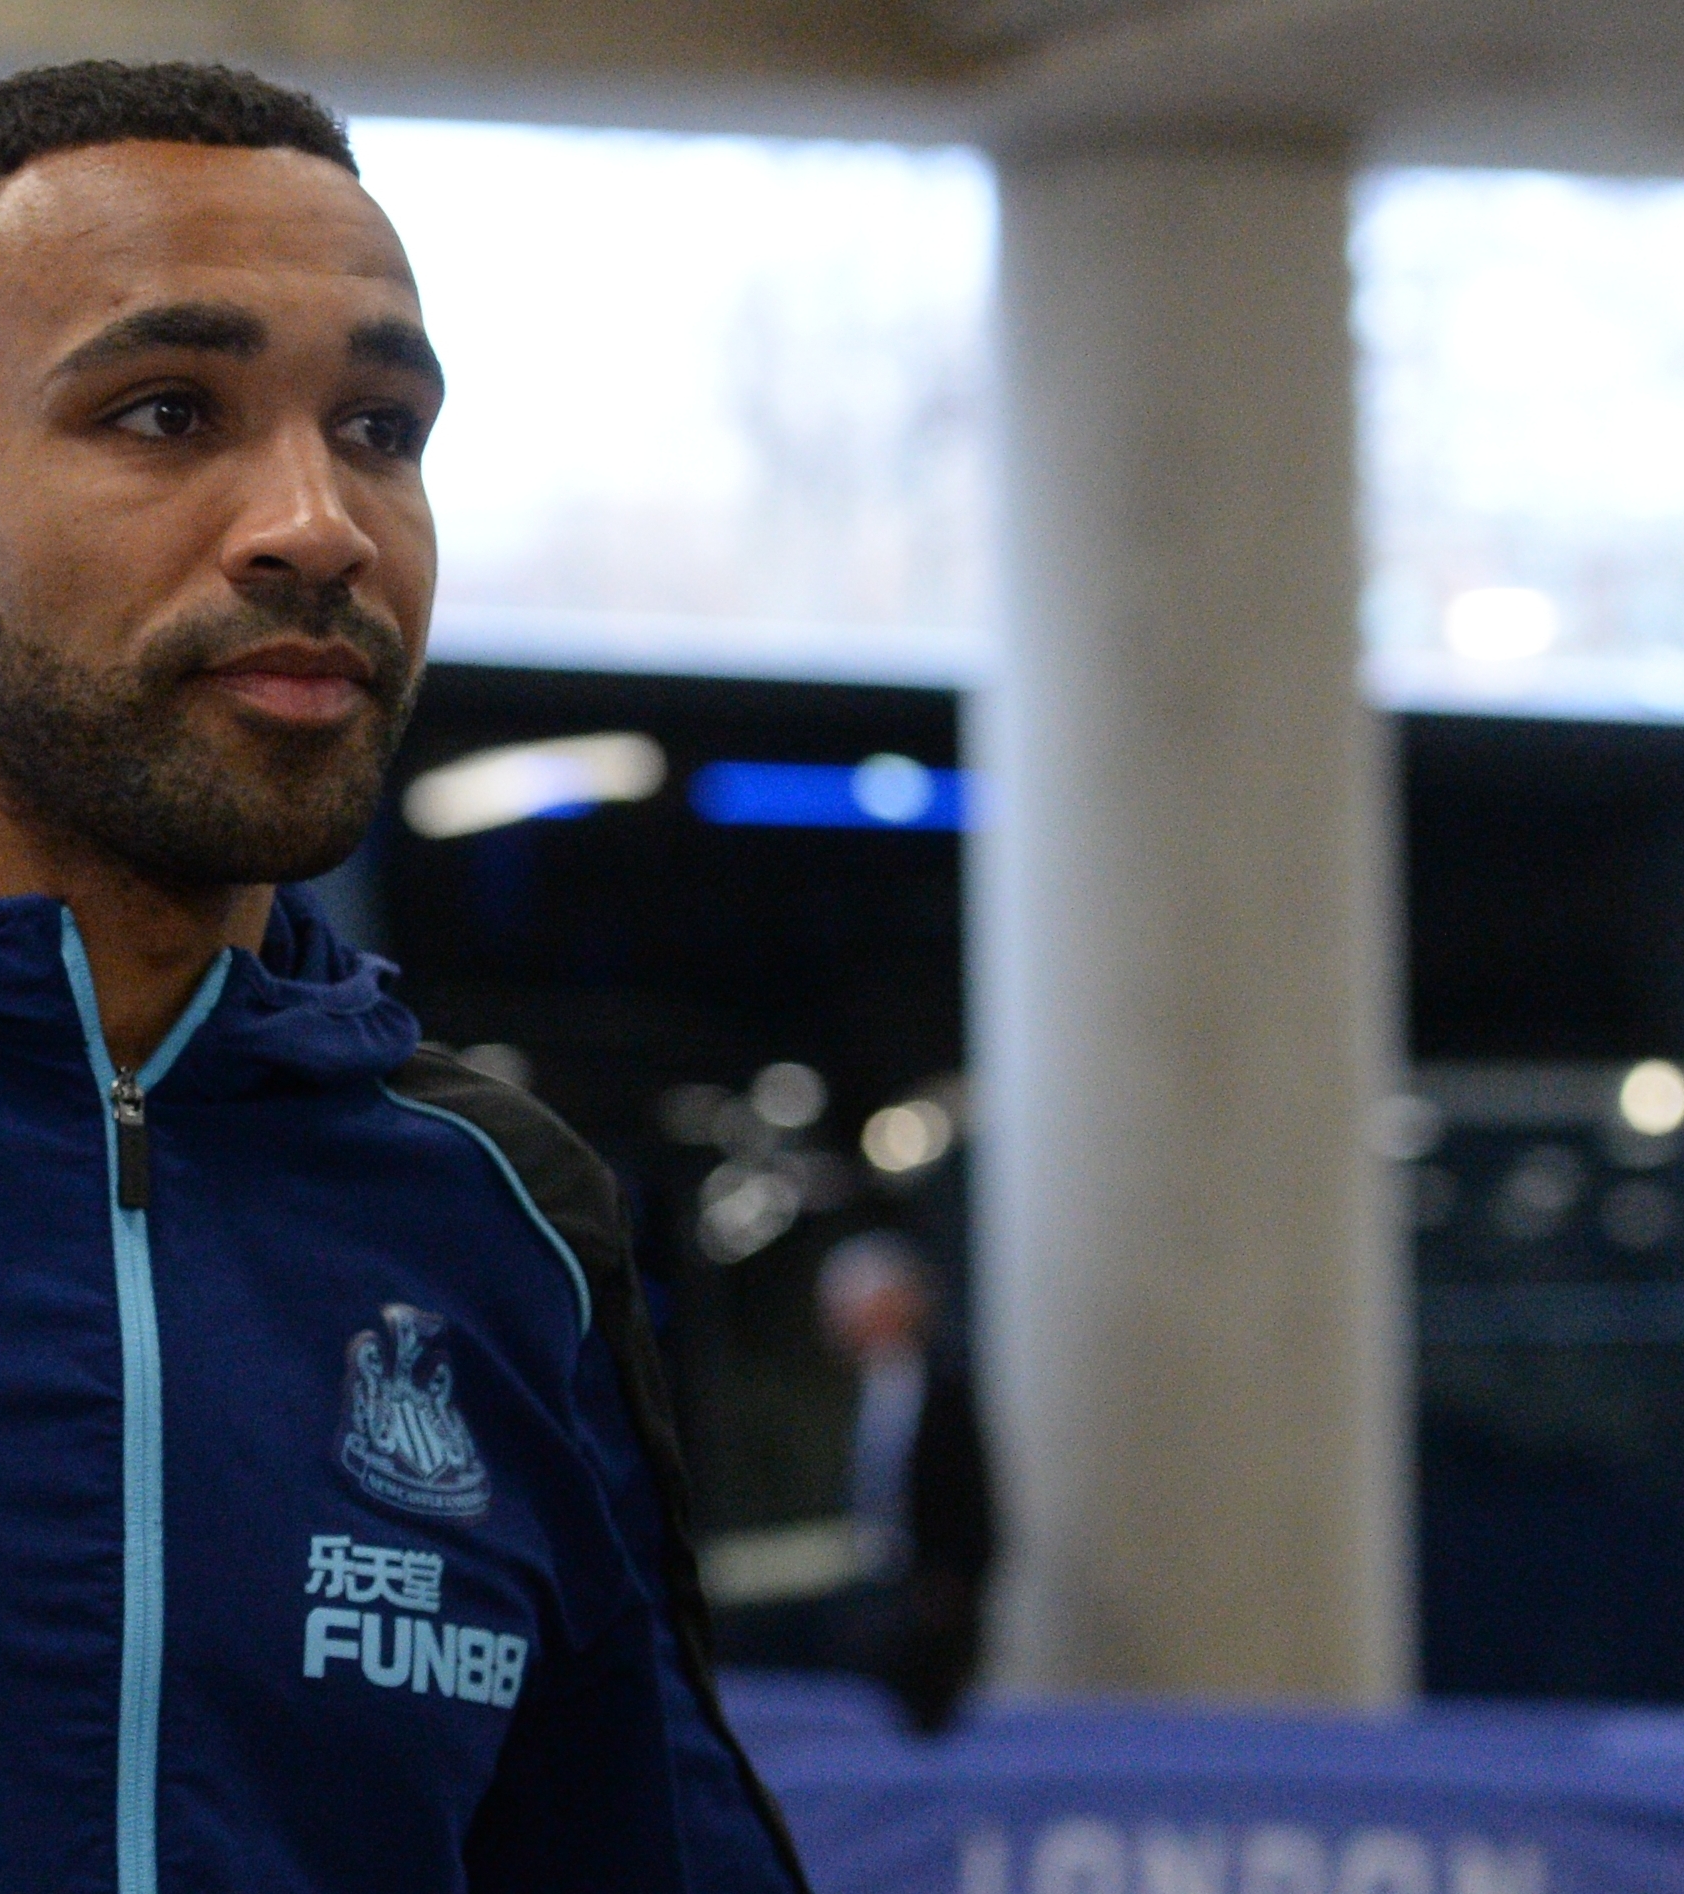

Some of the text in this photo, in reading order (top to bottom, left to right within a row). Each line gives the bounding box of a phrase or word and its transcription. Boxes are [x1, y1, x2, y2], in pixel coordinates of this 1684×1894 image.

[304, 1535, 444, 1613] 乐天堂
[303, 1607, 529, 1709] FUN88
